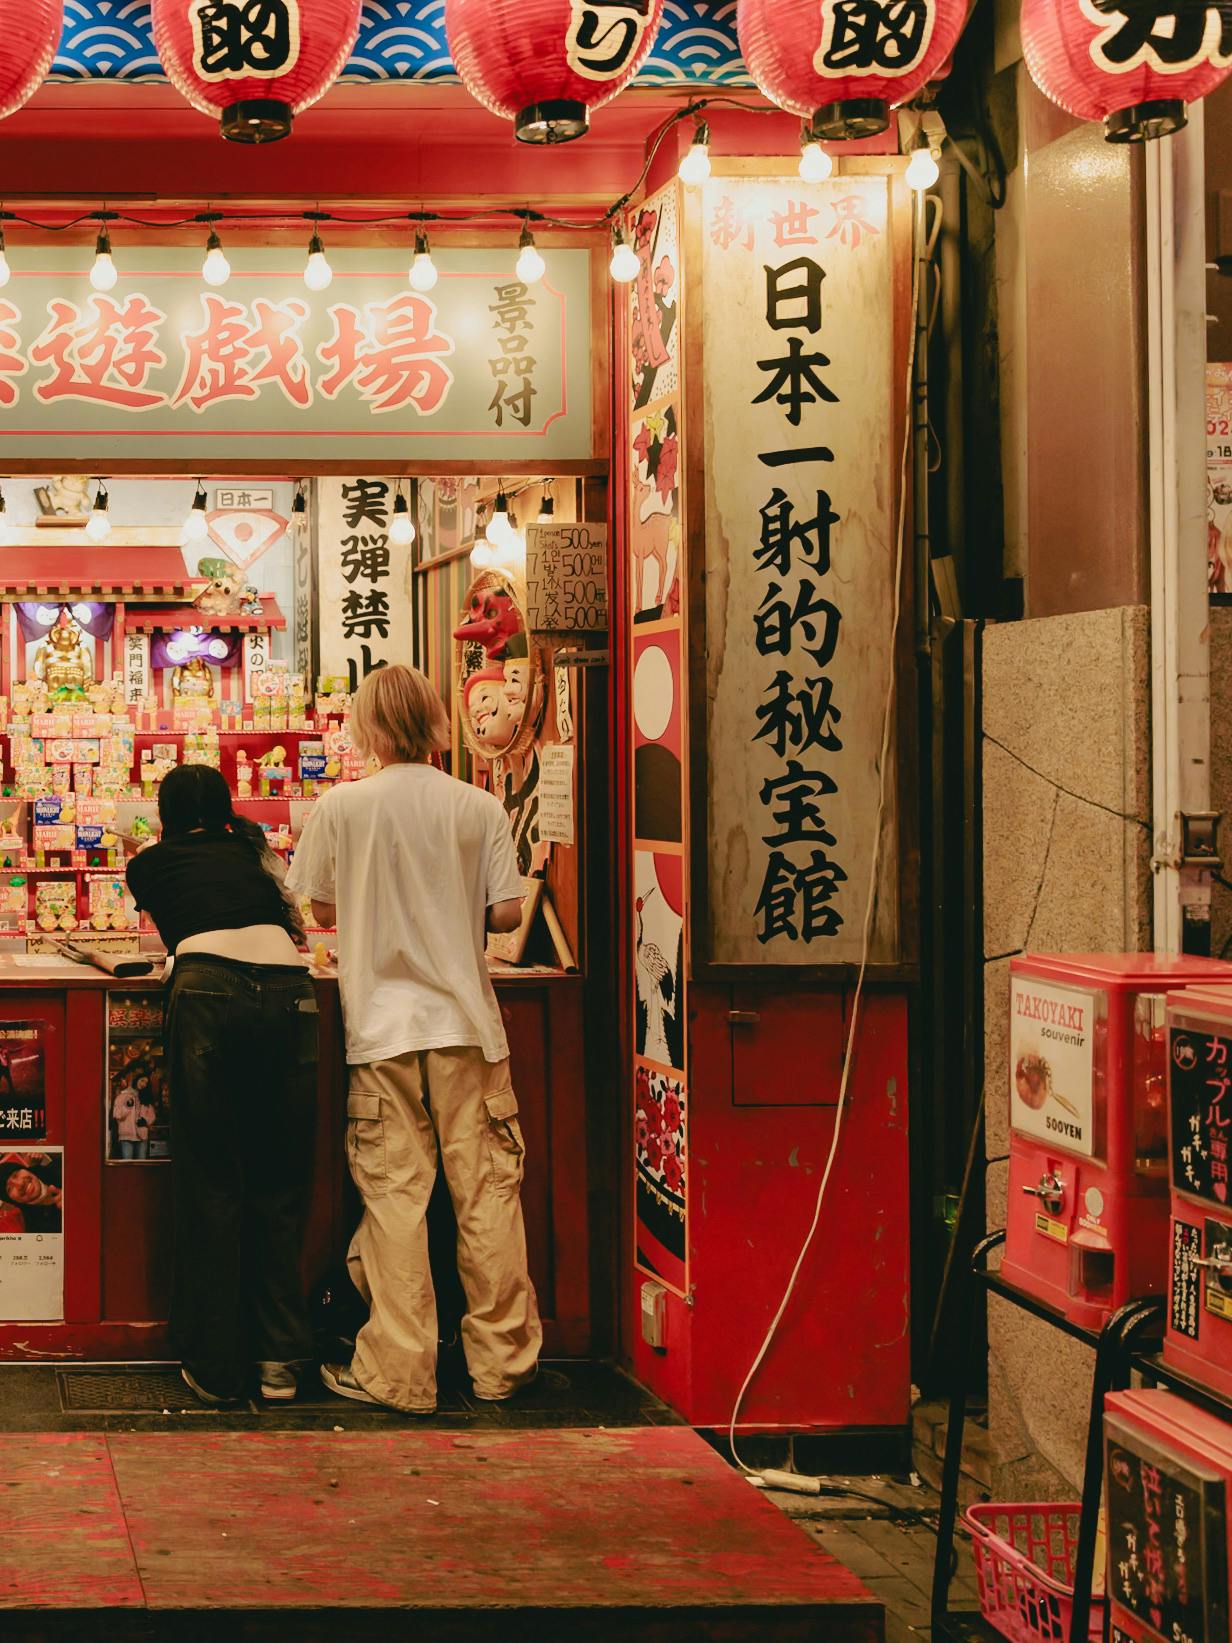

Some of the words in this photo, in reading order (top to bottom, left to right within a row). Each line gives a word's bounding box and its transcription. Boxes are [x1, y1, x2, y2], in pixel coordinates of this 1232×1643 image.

[708, 194, 882, 251] 新世界
[488, 282, 537, 428] 景品付
[220, 491, 268, 508] 日本一
[340, 478, 391, 696] 実弾禁止
[750, 256, 849, 945] 日本一射的秘宝館
[128, 636, 144, 703] 笑門福来
[249, 636, 265, 675] 火の
[1015, 992, 1084, 1032] TAKOYAKI
[1040, 1026, 1085, 1048] souvenir
